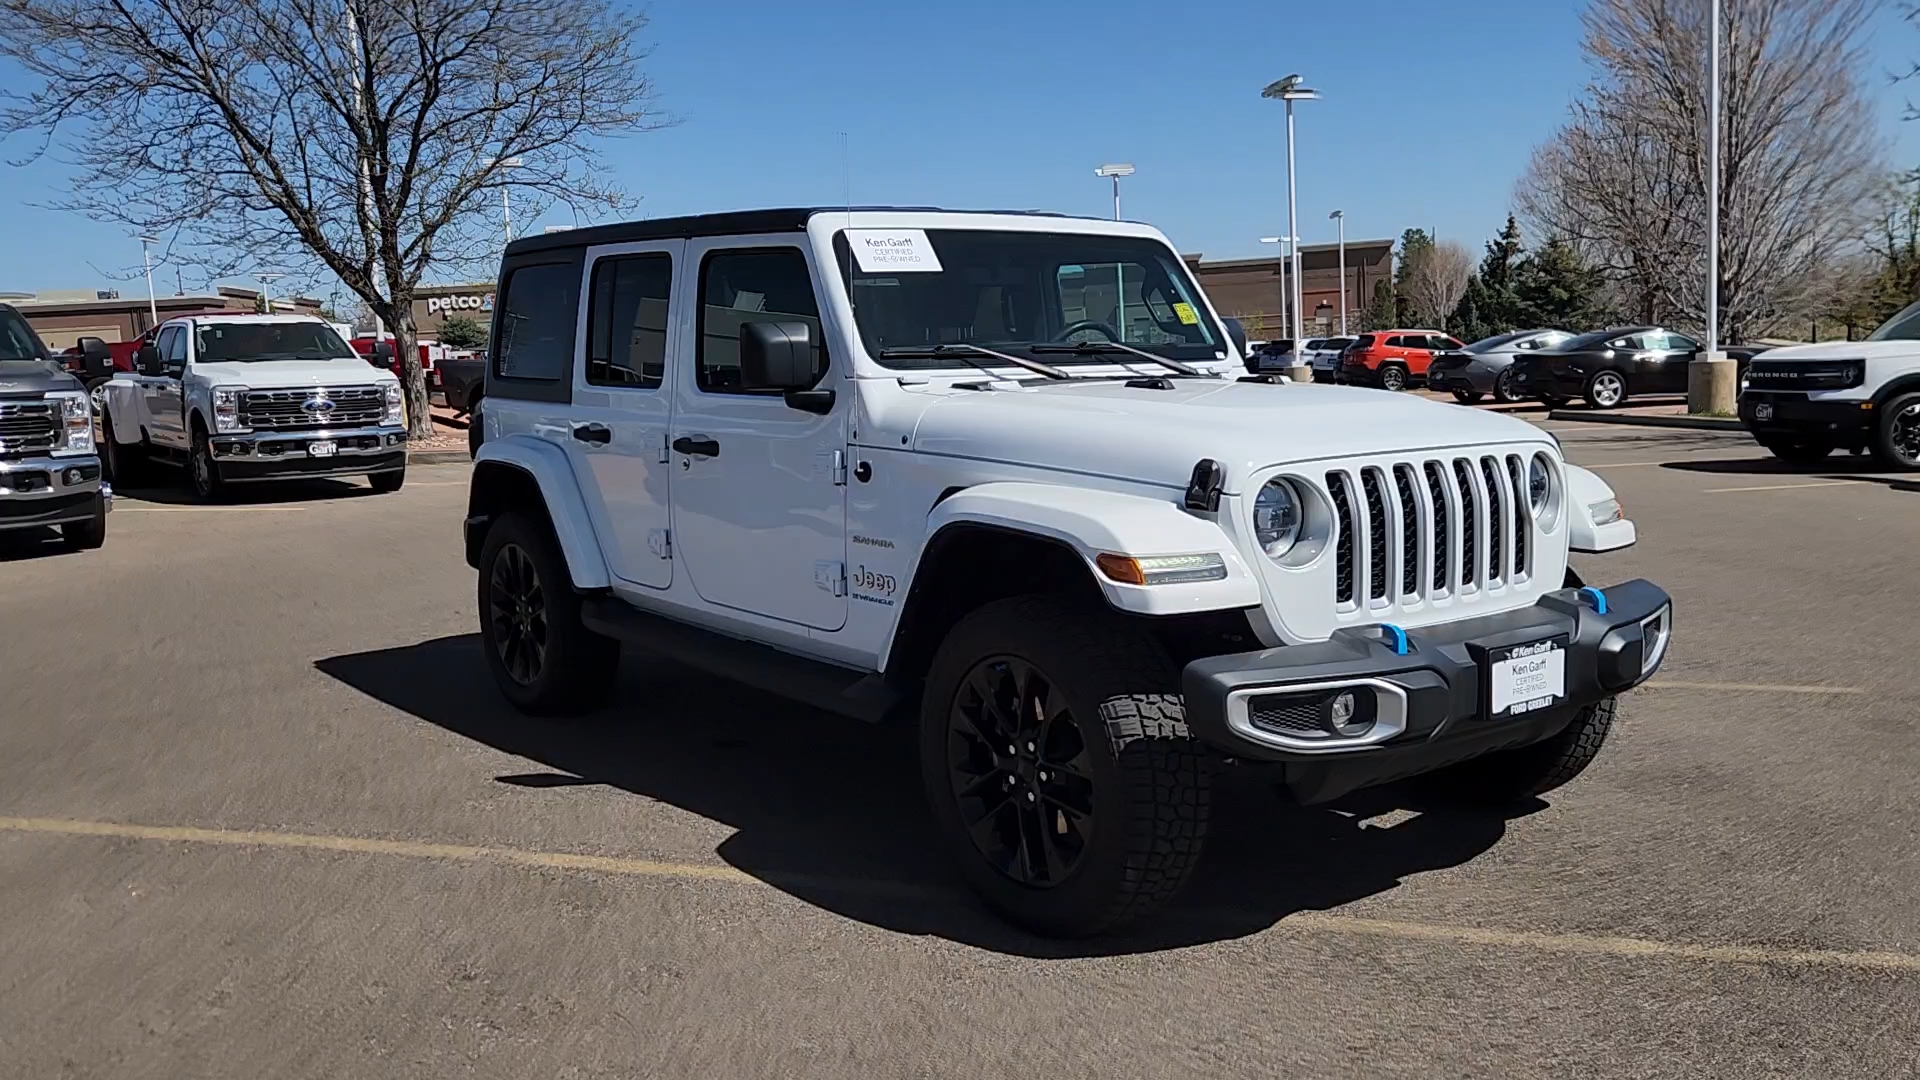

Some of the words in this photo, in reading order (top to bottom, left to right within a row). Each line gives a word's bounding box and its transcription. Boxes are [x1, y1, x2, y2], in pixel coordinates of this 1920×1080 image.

[865, 238, 887, 247] Ken
[888, 237, 913, 247] Garff
[427, 294, 481, 314] petco
[852, 535, 895, 549] SAHARA
[853, 564, 896, 597] Jeep
[1512, 663, 1528, 676] Ken
[1529, 658, 1547, 672] Garff
[1515, 673, 1544, 686] CERTIFIED
